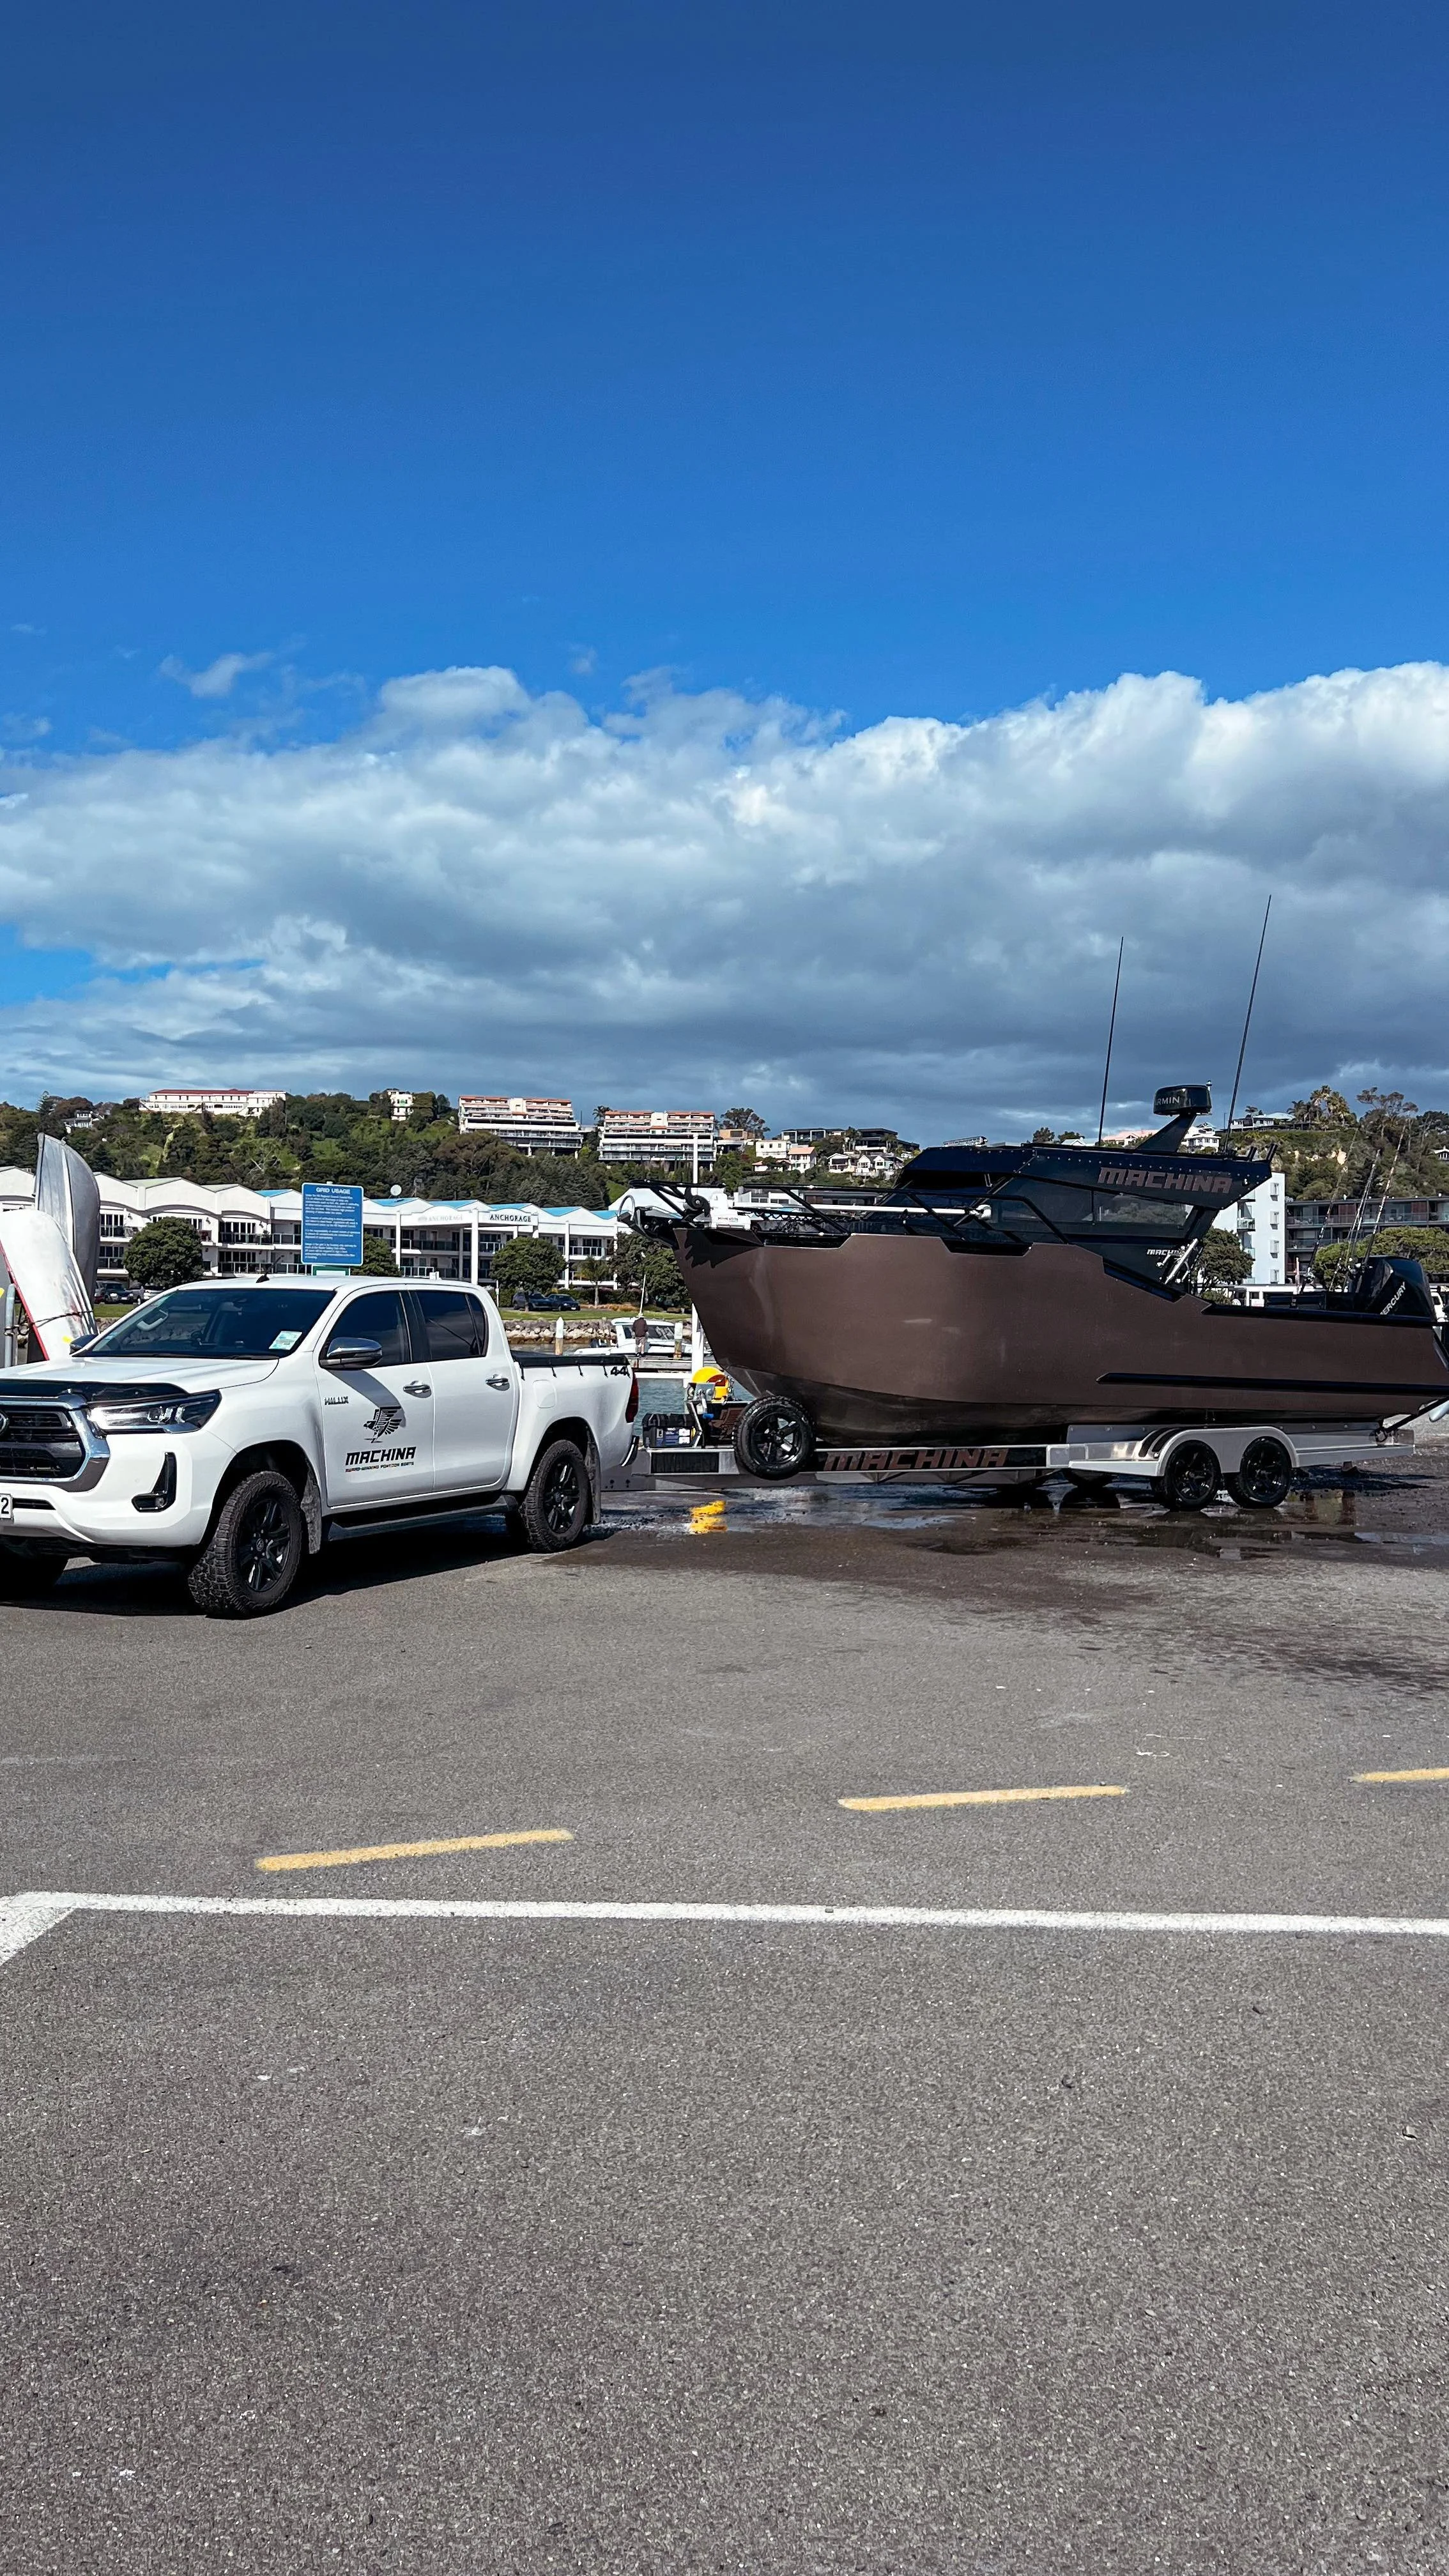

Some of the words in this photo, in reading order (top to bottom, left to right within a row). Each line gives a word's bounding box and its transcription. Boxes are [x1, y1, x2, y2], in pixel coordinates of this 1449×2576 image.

[1098, 1167, 1233, 1194] MACHINA
[489, 1214, 532, 1223] ANCHORAGE
[345, 1446, 417, 1466] MACHINA
[823, 1448, 1009, 1471] MACHINA
